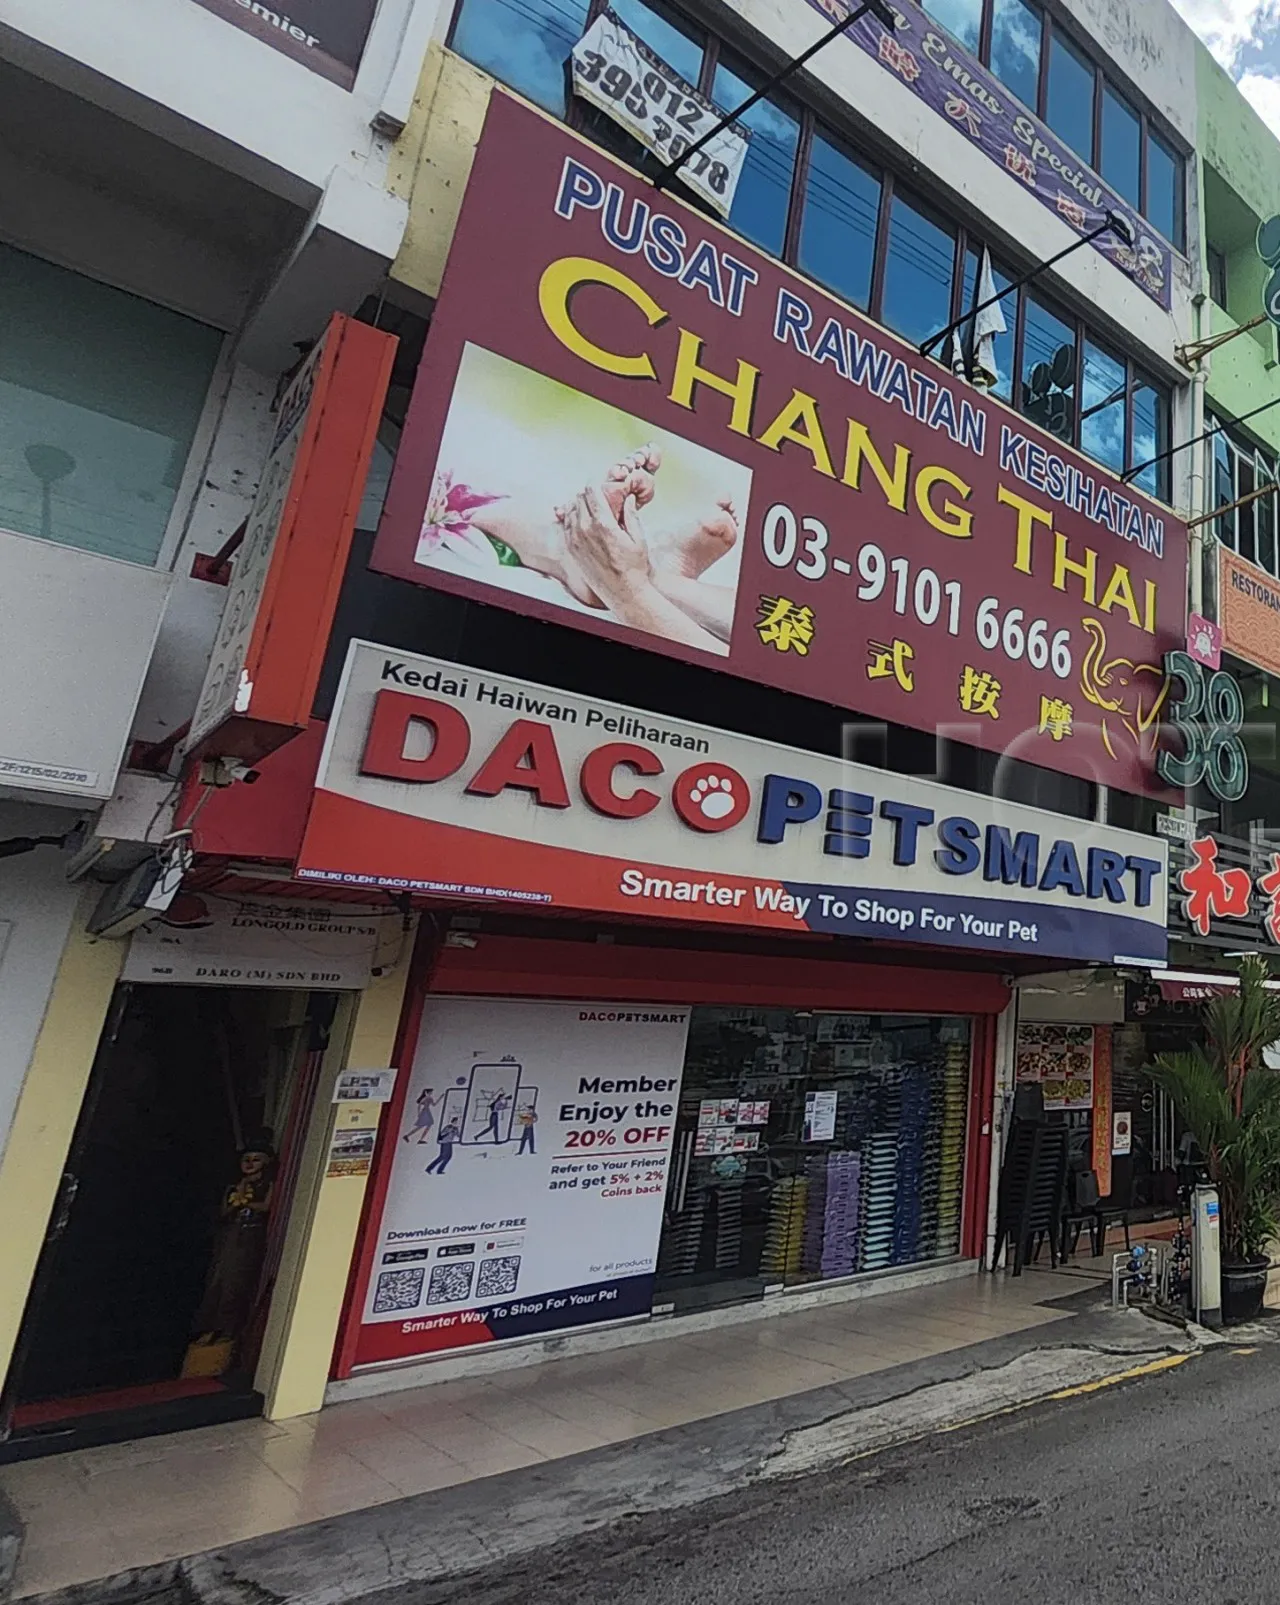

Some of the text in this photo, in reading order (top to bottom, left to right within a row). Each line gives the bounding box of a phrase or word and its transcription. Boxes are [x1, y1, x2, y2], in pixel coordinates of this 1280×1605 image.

[922, 32, 1003, 114] Emas
[1013, 116, 1105, 208] Special
[554, 156, 1164, 559] PUSAT RAWATAN KESIHATAN
[538, 256, 1158, 635] CHANG THAI
[761, 503, 1072, 679] 03-9101 6666
[754, 595, 1075, 742] 泰式按摩
[381, 660, 711, 755] Kedai Haiwan Peliharaan
[757, 774, 1162, 907] PETSMART
[298, 868, 342, 881] DIMILIKI
[378, 877, 408, 888] DACO
[410, 880, 463, 893] PETSMART
[464, 885, 484, 896] SDN
[619, 869, 1039, 943] Smarter Way To Shop For Your Pet
[308, 923, 356, 935] GROUP
[195, 966, 241, 979] DARO
[276, 970, 306, 981] SDN
[311, 973, 341, 983] BHD
[578, 1075, 677, 1094] Member
[559, 1101, 674, 1124] Enjoy the
[564, 1126, 671, 1149] 20% OFF
[551, 1156, 666, 1175] Refer to Your Friend
[548, 1177, 578, 1191] and
[581, 1175, 606, 1190] get
[609, 1173, 630, 1186] 5%
[644, 1169, 664, 1182] 2%
[601, 1183, 663, 1199] Coins back
[387, 1217, 527, 1241] Download now for FREE
[589, 1265, 602, 1273] for
[603, 1262, 614, 1271] all
[615, 1257, 653, 1271] products
[401, 1288, 618, 1334] Smarter Way To Shop For Your Pet
